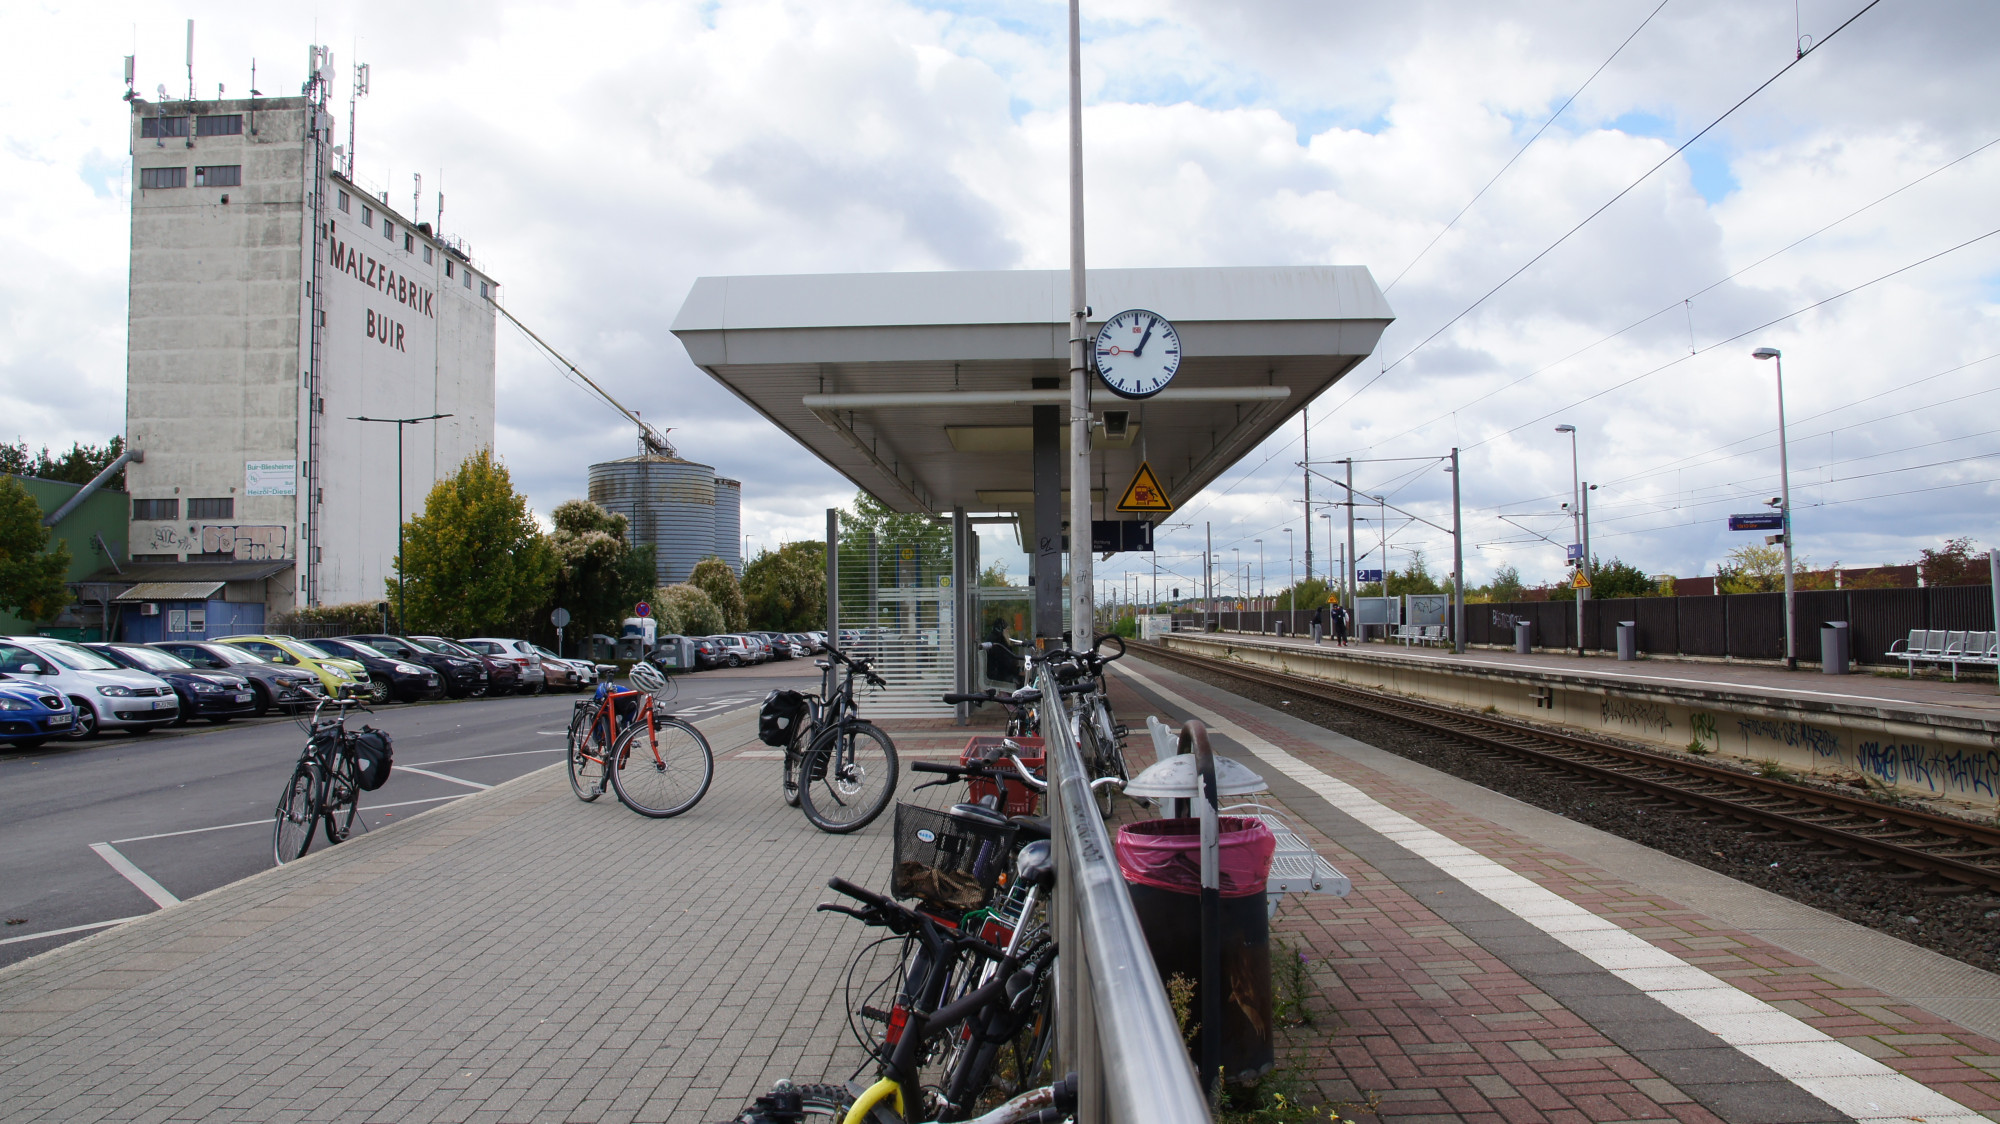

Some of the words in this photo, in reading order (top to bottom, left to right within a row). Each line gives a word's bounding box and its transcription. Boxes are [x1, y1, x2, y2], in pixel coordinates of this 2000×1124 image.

[330, 235, 434, 319] MALZFABRIK
[366, 307, 406, 353] BUIR
[1140, 521, 1150, 545] 1
[1358, 570, 1366, 580] 2
